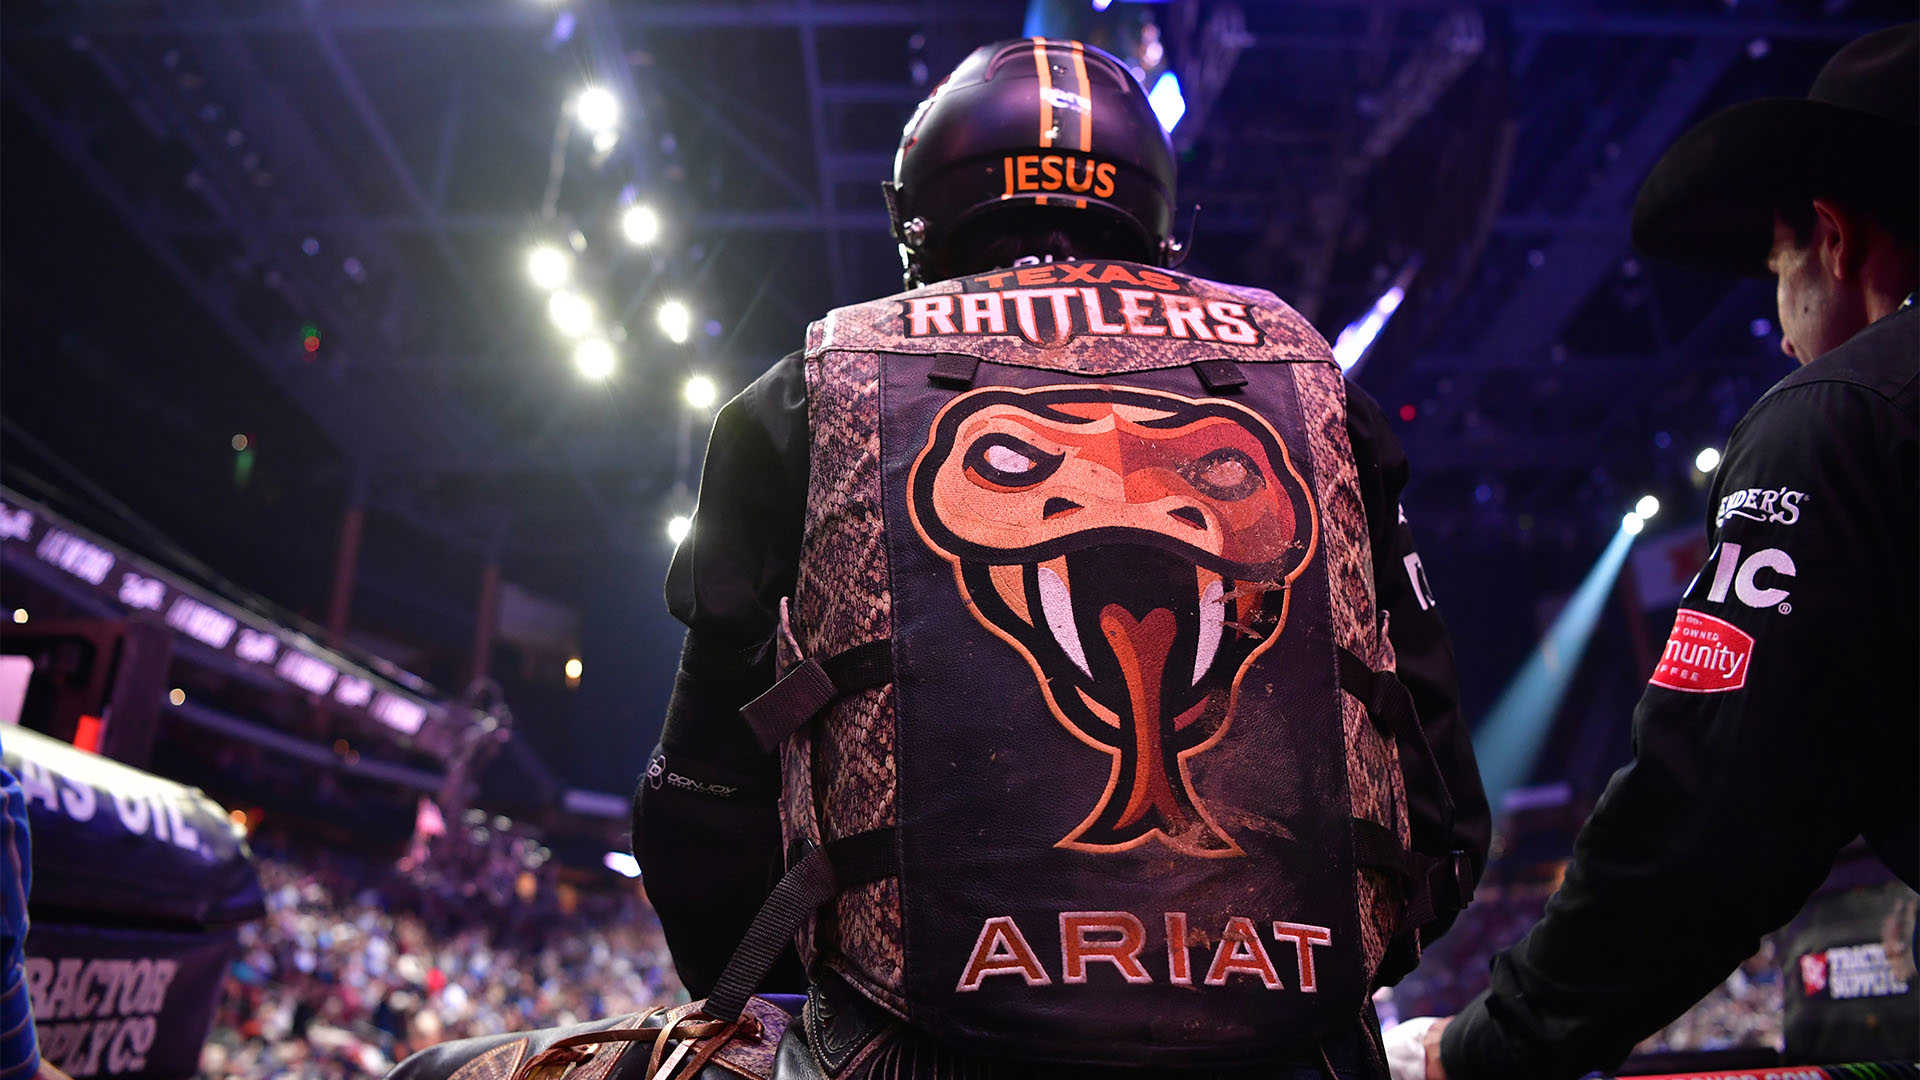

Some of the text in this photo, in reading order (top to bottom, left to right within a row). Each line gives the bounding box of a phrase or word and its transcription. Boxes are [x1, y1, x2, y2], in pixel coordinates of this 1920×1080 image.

[1001, 155, 1117, 200] JESUS
[974, 263, 1181, 291] TEXAS
[905, 286, 1264, 346] RATTLERS
[1683, 627, 1720, 641] OWNED
[1656, 663, 1700, 682] FFEE
[956, 911, 1331, 993] ARIAT
